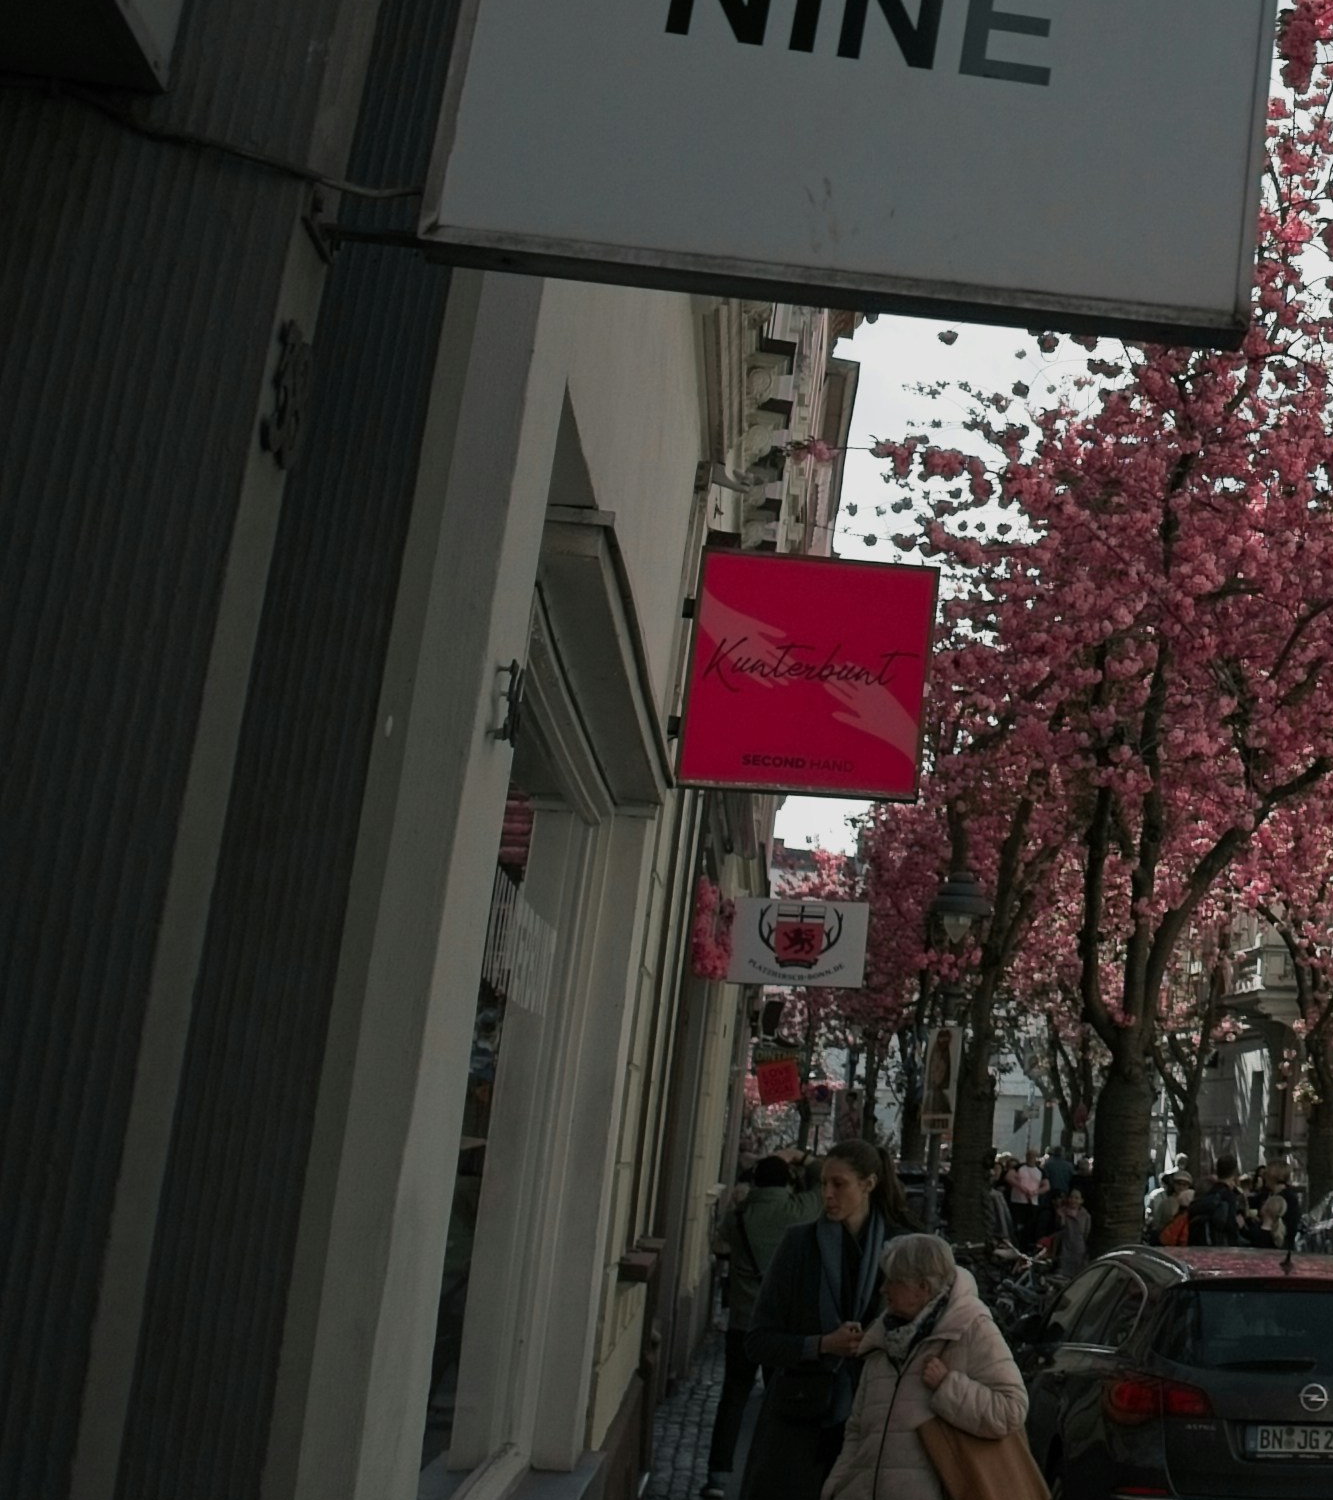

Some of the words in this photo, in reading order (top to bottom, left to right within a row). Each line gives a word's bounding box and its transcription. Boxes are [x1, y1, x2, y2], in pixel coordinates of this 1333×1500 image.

[703, 636, 920, 693] Kunterbunt
[741, 754, 806, 770] SECOND
[809, 759, 856, 774] HAND
[1260, 1429, 1283, 1450] BN
[1297, 1429, 1320, 1451] JG
